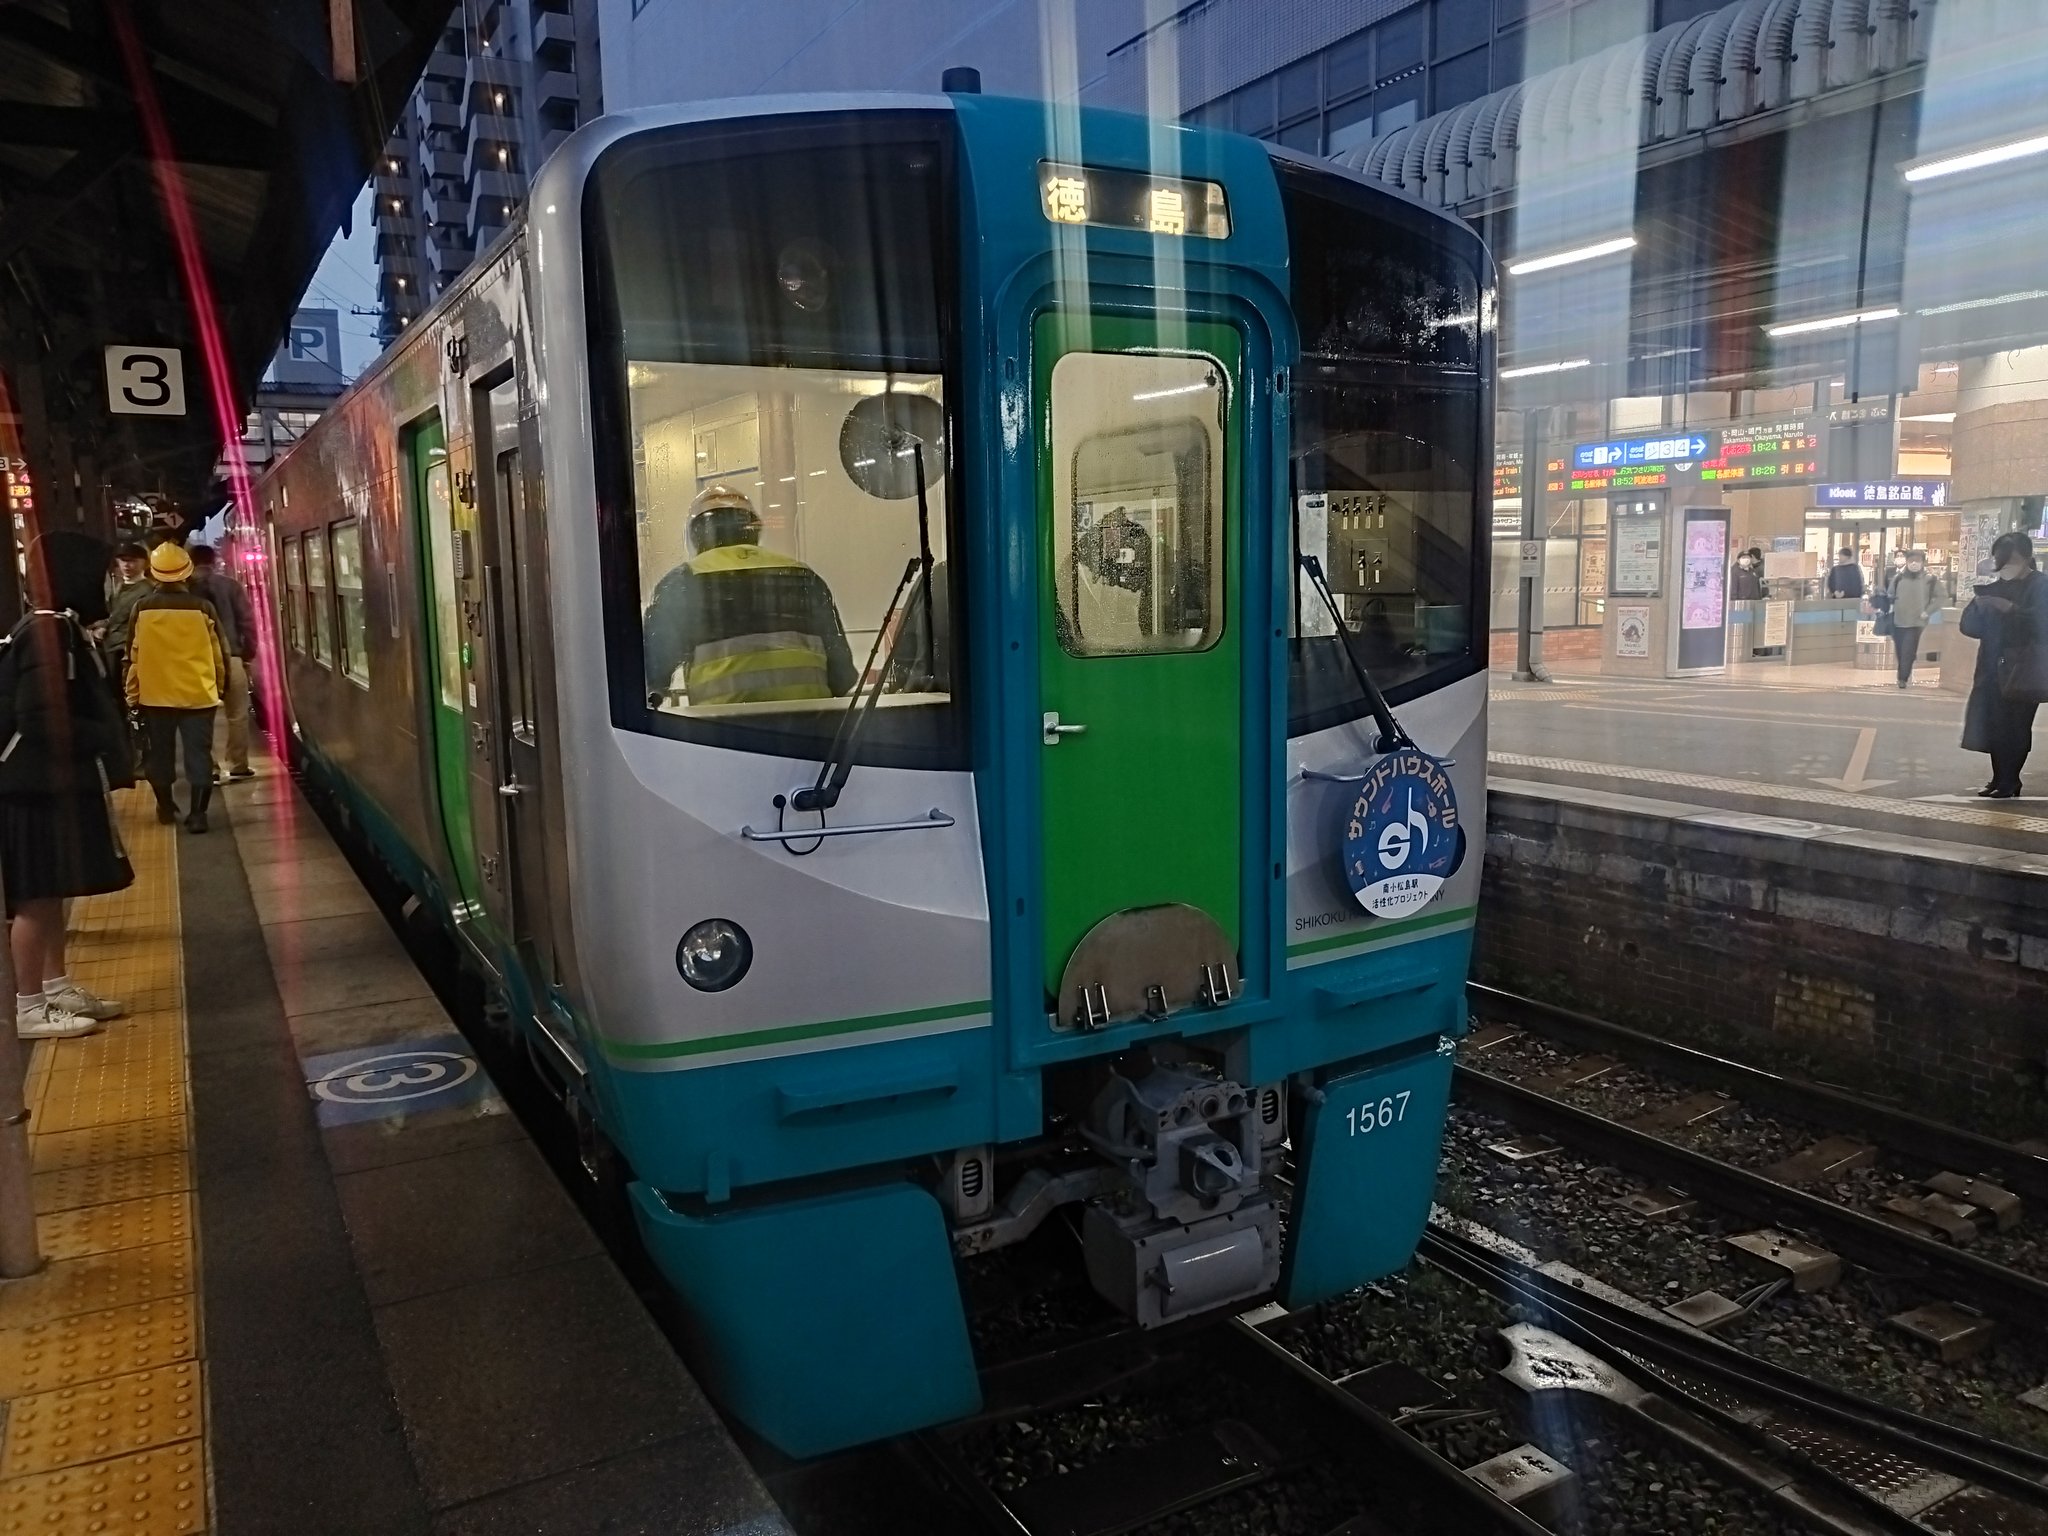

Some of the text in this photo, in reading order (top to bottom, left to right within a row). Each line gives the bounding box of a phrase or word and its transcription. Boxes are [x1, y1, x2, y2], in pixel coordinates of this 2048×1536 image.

[1047, 177, 1185, 235] 徳島
[291, 327, 324, 359] P
[121, 353, 171, 407] 3
[1783, 429, 1804, 439] Naruto
[1662, 443, 1672, 456] 3
[1677, 441, 1687, 453] 4
[1753, 442, 1777, 453] 18:24
[1781, 439, 1806, 450] 高松
[1809, 438, 1817, 447] 2
[1505, 467, 1518, 475] Train
[1751, 466, 1776, 476] 18:26
[1780, 463, 1804, 475] 引田
[1807, 462, 1815, 472] 4
[20, 473, 30, 484] 4
[1558, 482, 1564, 490] 3
[1612, 477, 1633, 487] 18:52
[1659, 474, 1666, 483] 2
[1504, 486, 1517, 494] Train
[1829, 486, 1857, 498] Kiosk
[1863, 484, 1925, 501] 徳島銘品館
[22, 498, 33, 509] 3
[1348, 755, 1457, 841] サウンドハウスホール
[1382, 877, 1419, 894] 南小松島駅
[1371, 890, 1429, 909] 活性化プロジェクト
[1295, 911, 1346, 931] SHIKOKU
[1346, 1090, 1412, 1137] 1567
